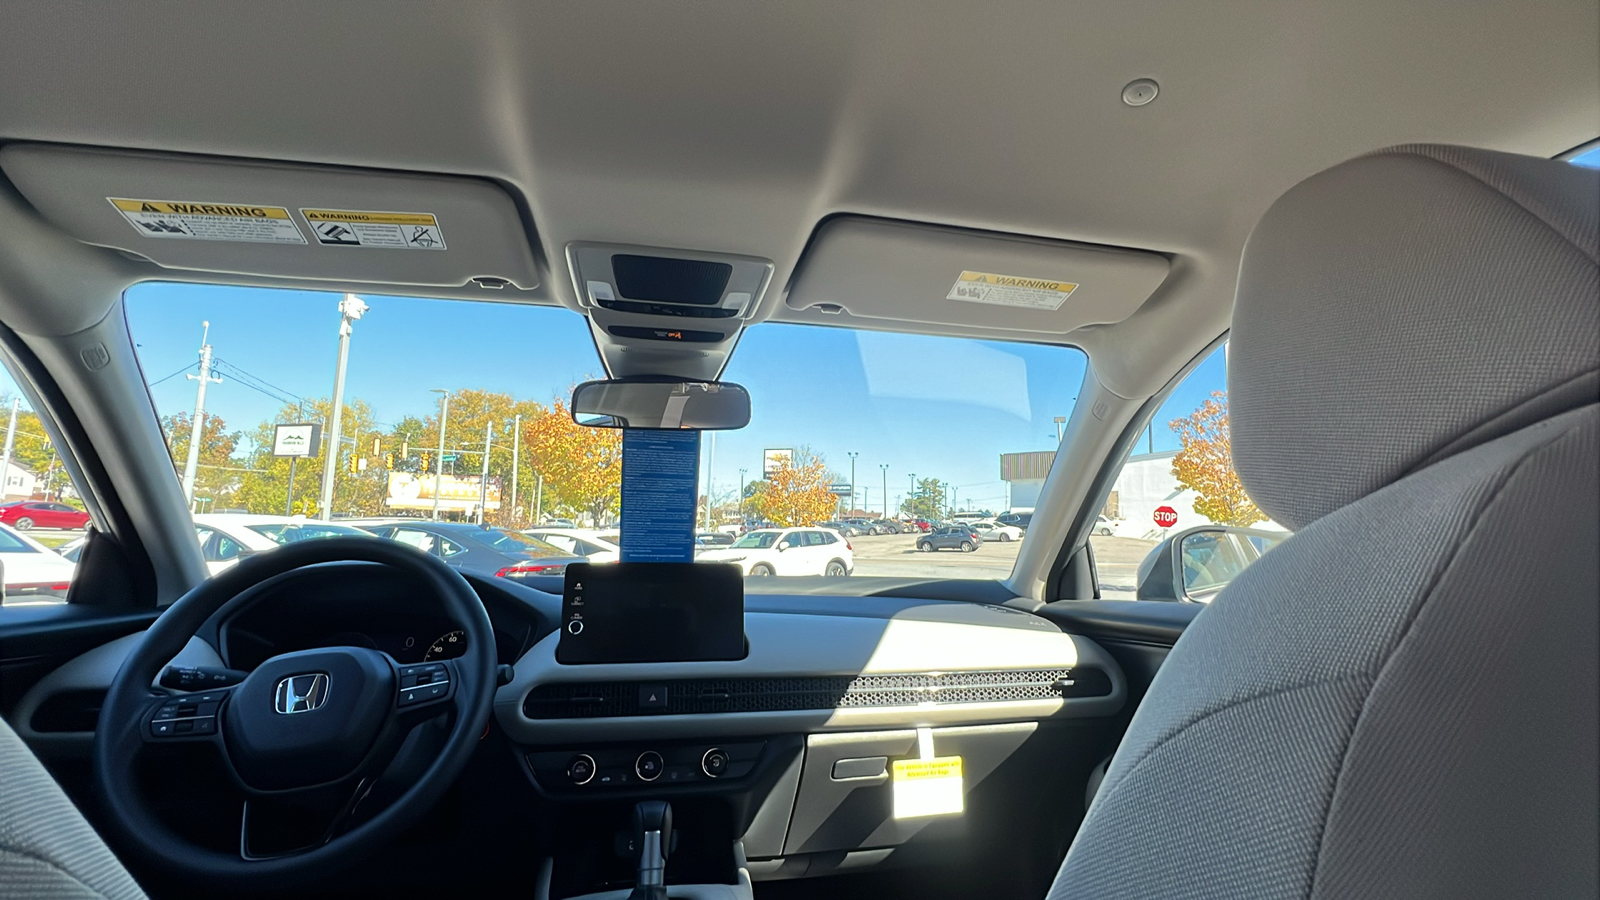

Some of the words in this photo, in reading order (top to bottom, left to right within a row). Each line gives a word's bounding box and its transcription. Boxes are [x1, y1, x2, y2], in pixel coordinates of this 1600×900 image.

[167, 204, 267, 217] WARNING
[320, 213, 370, 221] WARNING
[995, 276, 1060, 290] WARNING
[1154, 511, 1177, 522] STOP
